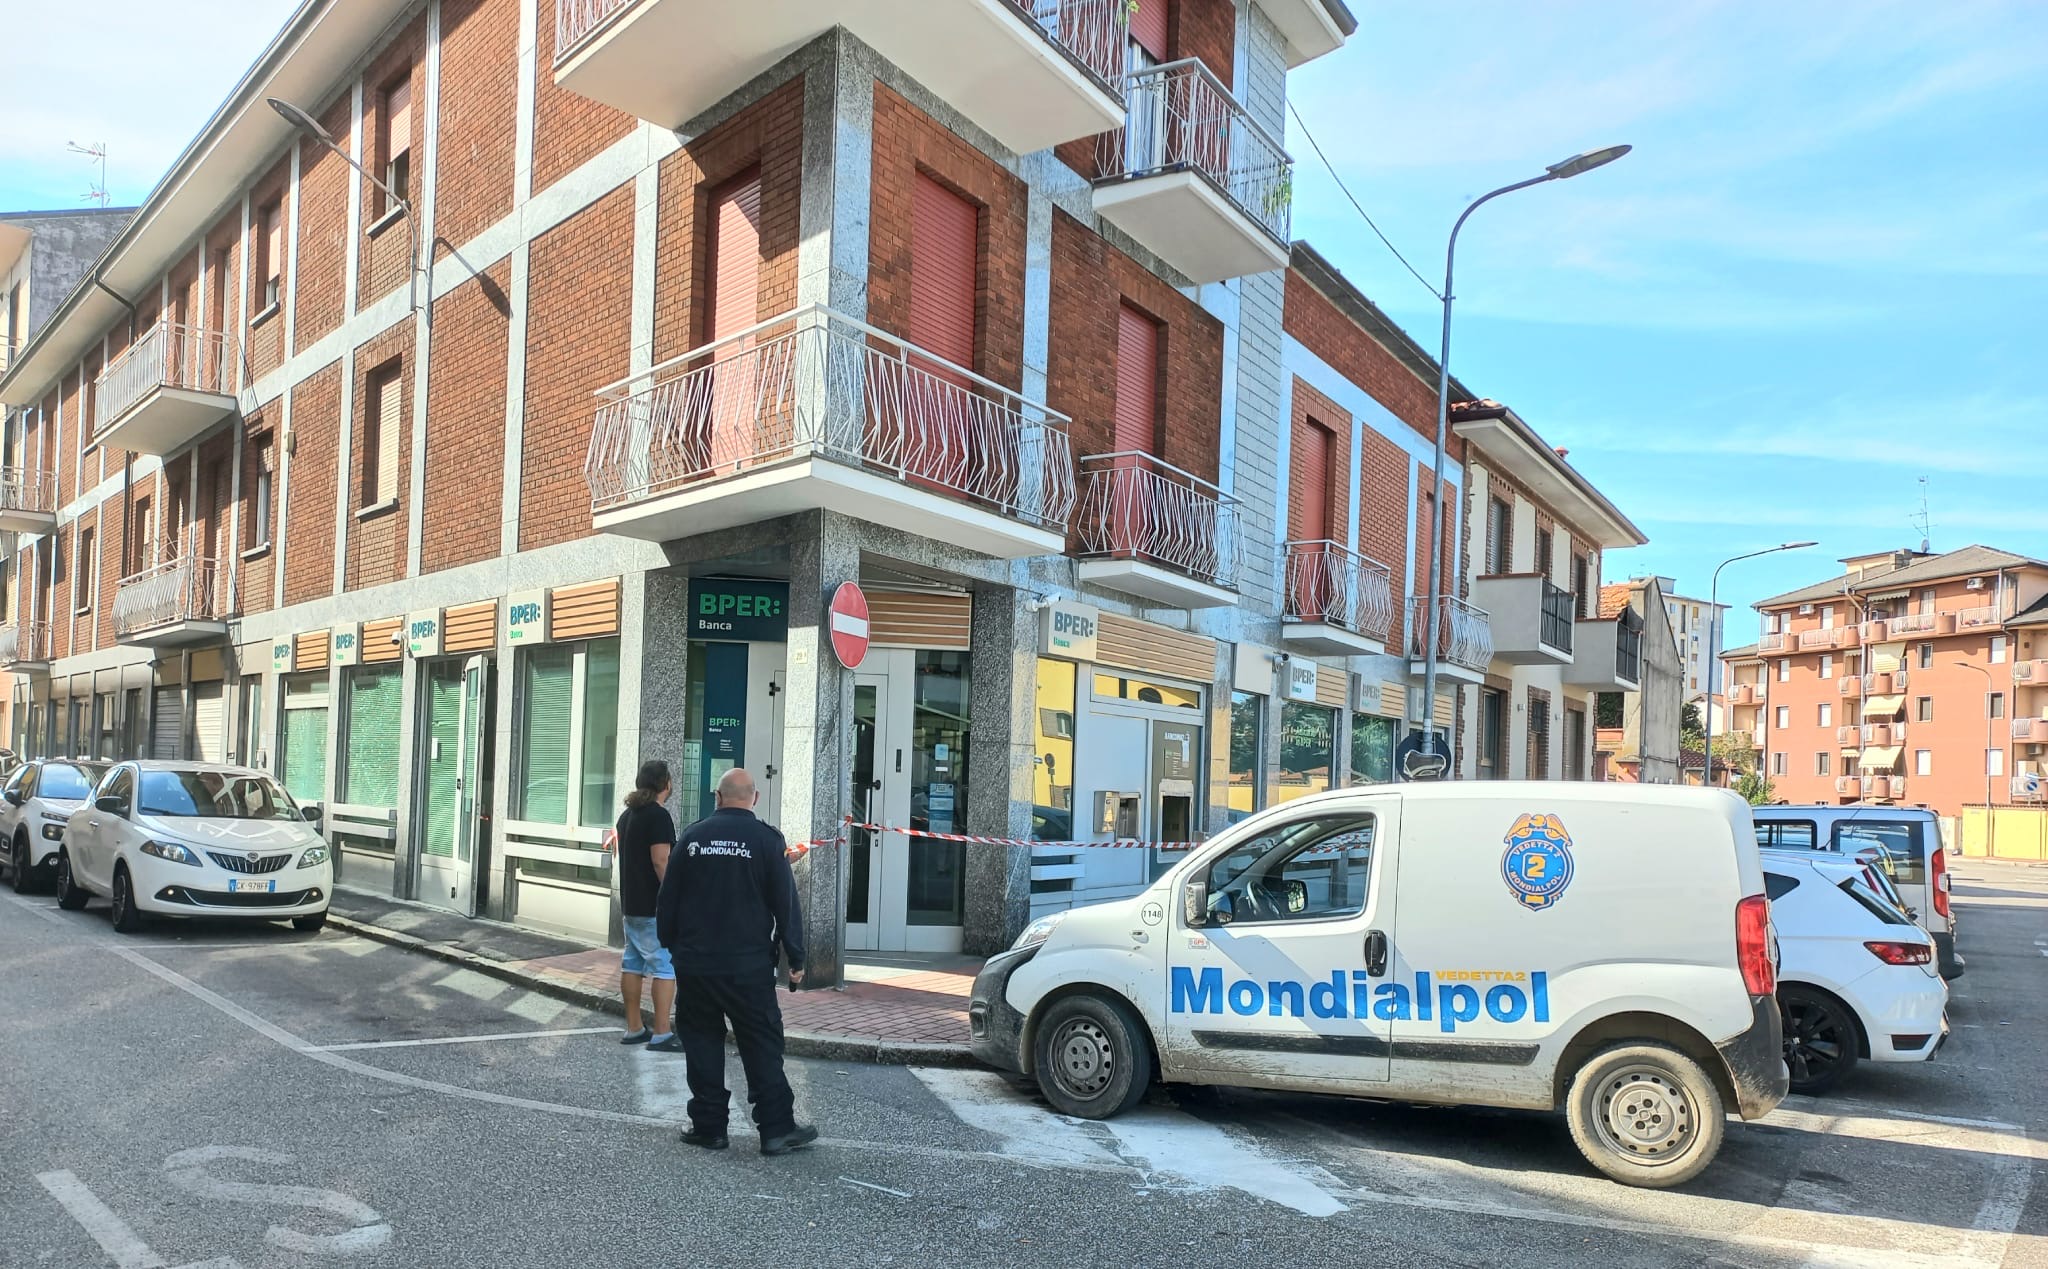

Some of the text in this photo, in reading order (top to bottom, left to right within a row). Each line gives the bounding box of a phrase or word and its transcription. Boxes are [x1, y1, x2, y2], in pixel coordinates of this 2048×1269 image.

[509, 602, 541, 626] BPER:
[698, 593, 781, 618] BPER:
[410, 620, 437, 640] BPER:
[698, 619, 732, 631] Banca
[1054, 610, 1094, 638] BPER:
[708, 717, 740, 727] BPER:
[700, 846, 753, 859] MONDIALPOL
[710, 840, 738, 848] VEDETTA
[1513, 840, 1554, 857] VEDETTA
[1526, 855, 1546, 878] 2
[1510, 871, 1562, 893] MONDIALPOL
[1143, 909, 1162, 919] 1148
[1434, 969, 1527, 982] VEDETTA2
[1170, 966, 1550, 1034] Mondialpol
